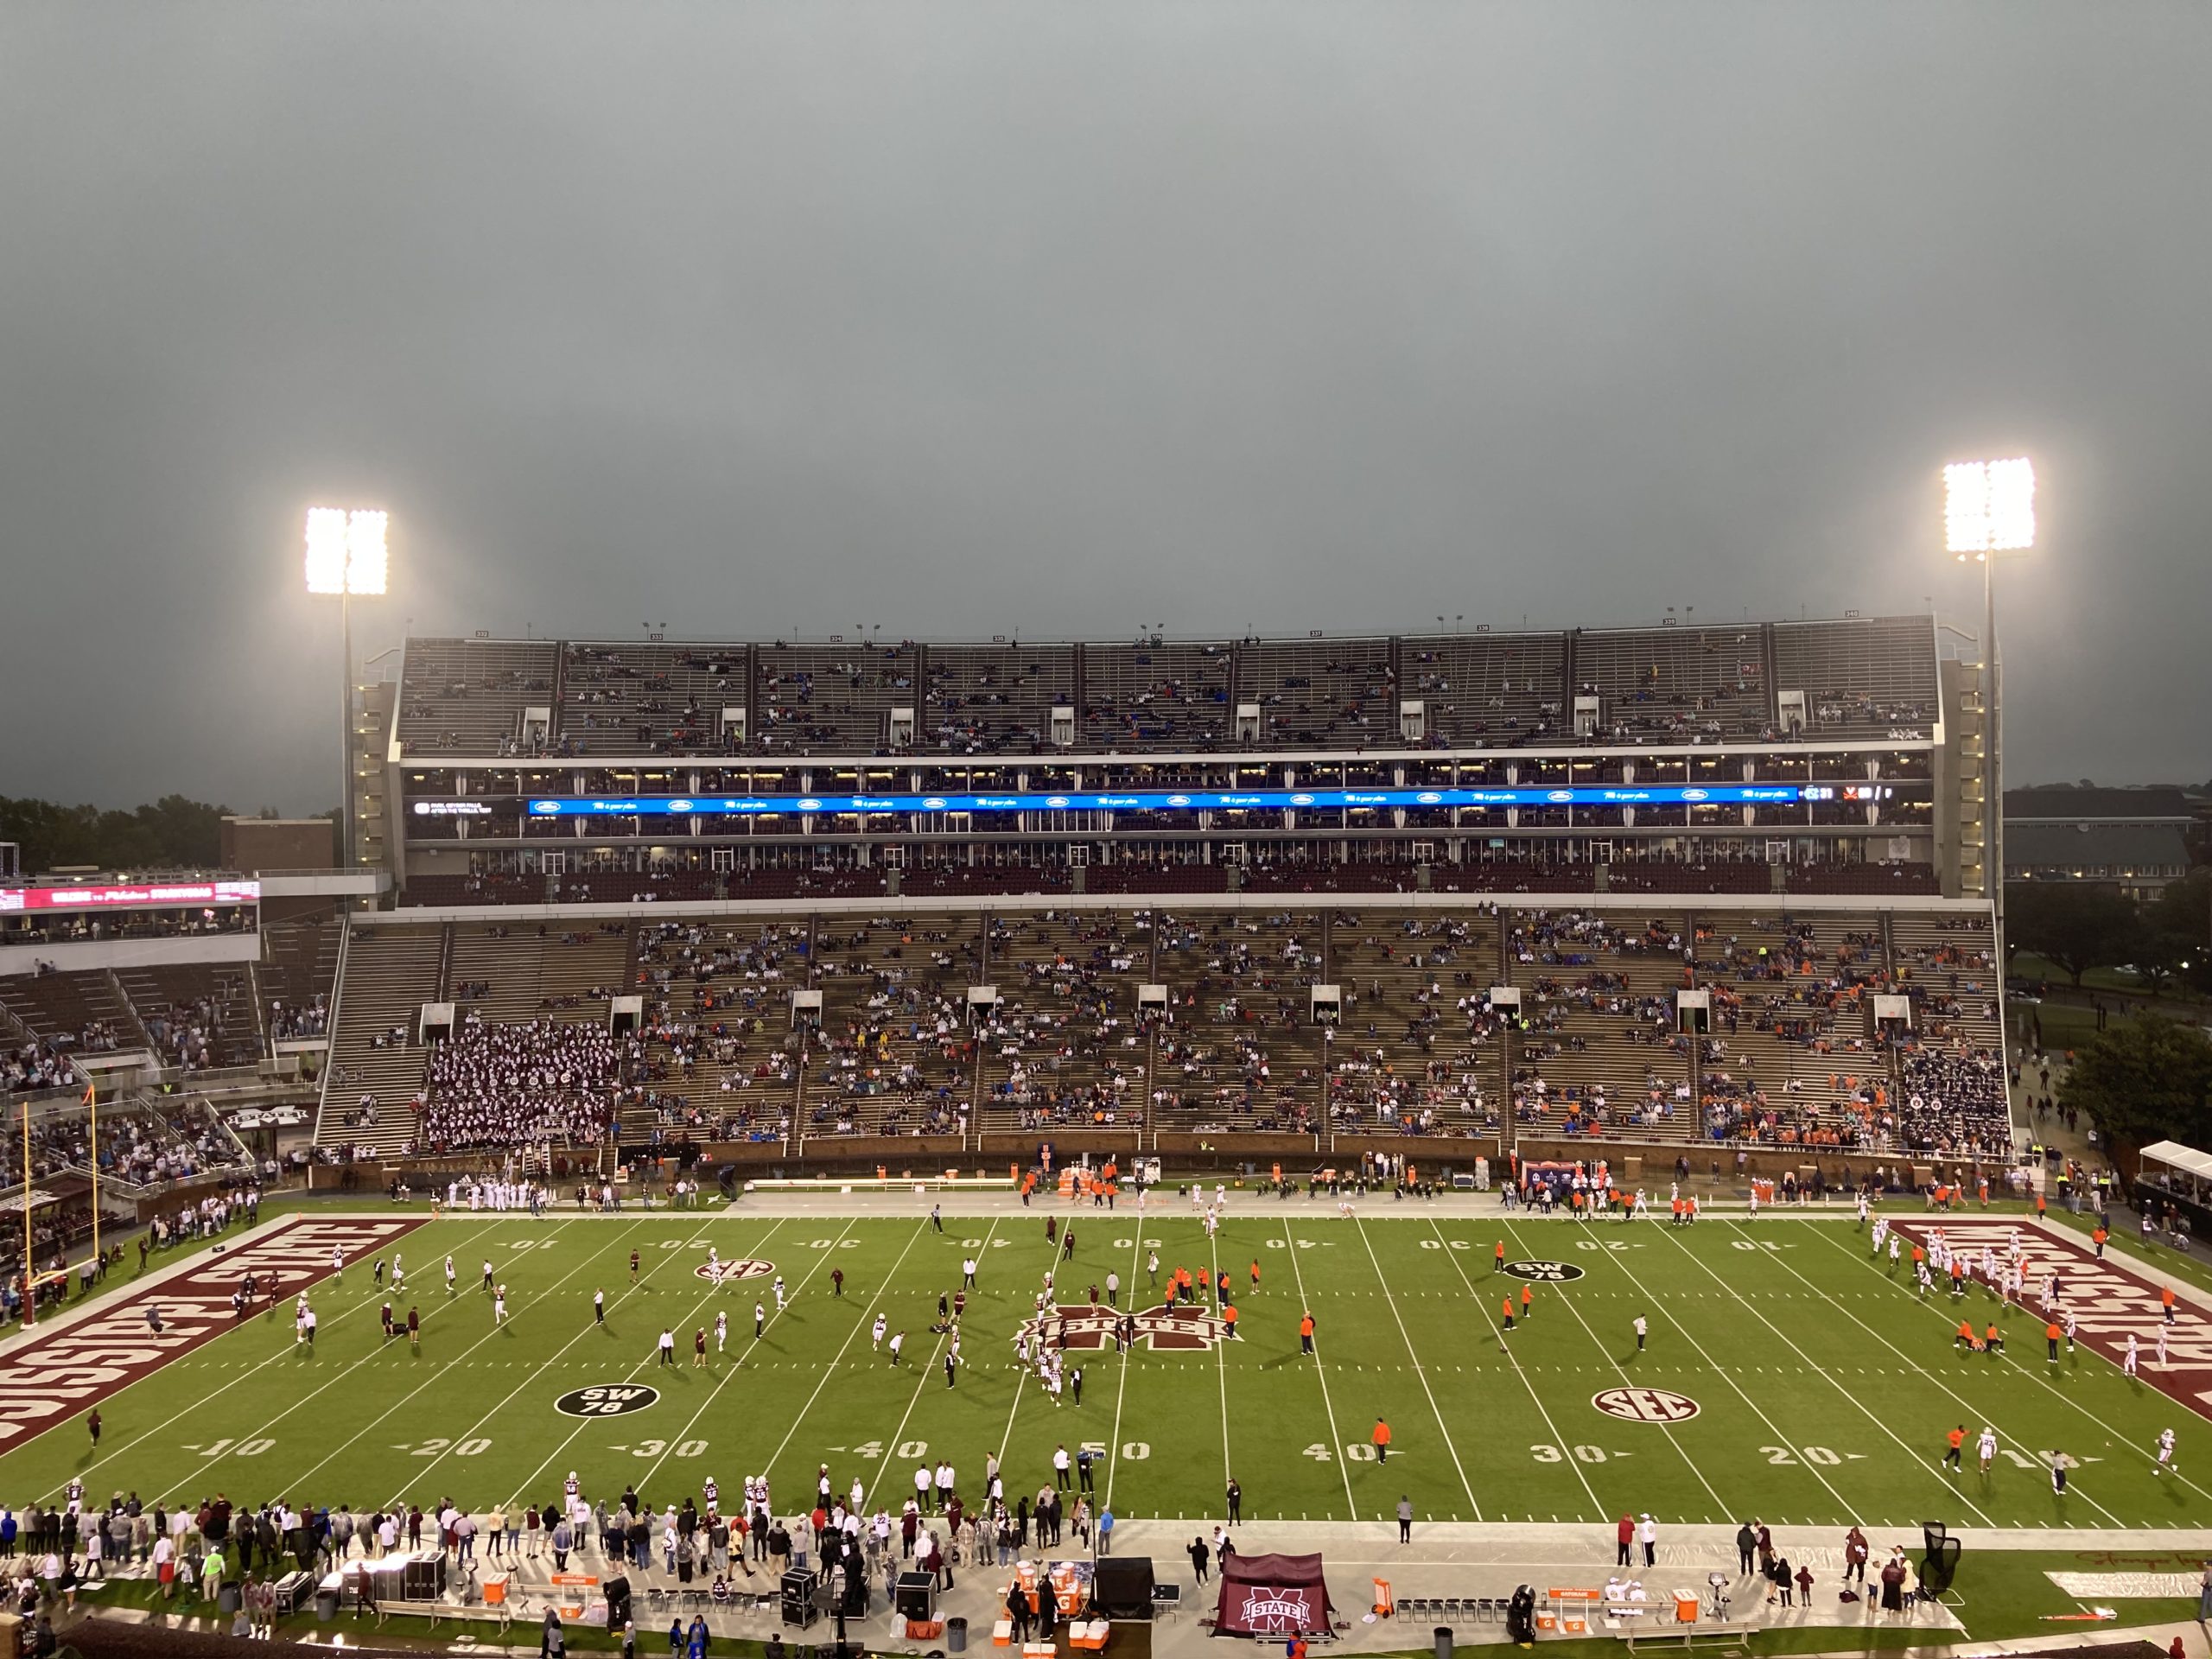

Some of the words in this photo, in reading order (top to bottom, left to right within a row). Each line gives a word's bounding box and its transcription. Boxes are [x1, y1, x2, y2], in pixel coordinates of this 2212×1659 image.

[243, 1111, 293, 1122] STATE
[188, 1224, 406, 1284] STATE
[580, 1388, 645, 1401] SW
[584, 1402, 623, 1414] 78
[1602, 1390, 1692, 1421] SEC
[198, 1439, 276, 1456] 10
[410, 1439, 492, 1456] 20
[632, 1440, 709, 1457] 30
[853, 1440, 929, 1459] 40
[1529, 1445, 1608, 1463] 30
[1759, 1446, 1841, 1465] 20
[2075, 1551, 2171, 1570] Stronger
[1058, 1596, 1071, 1610] G
[1255, 1603, 1297, 1616] STATE
